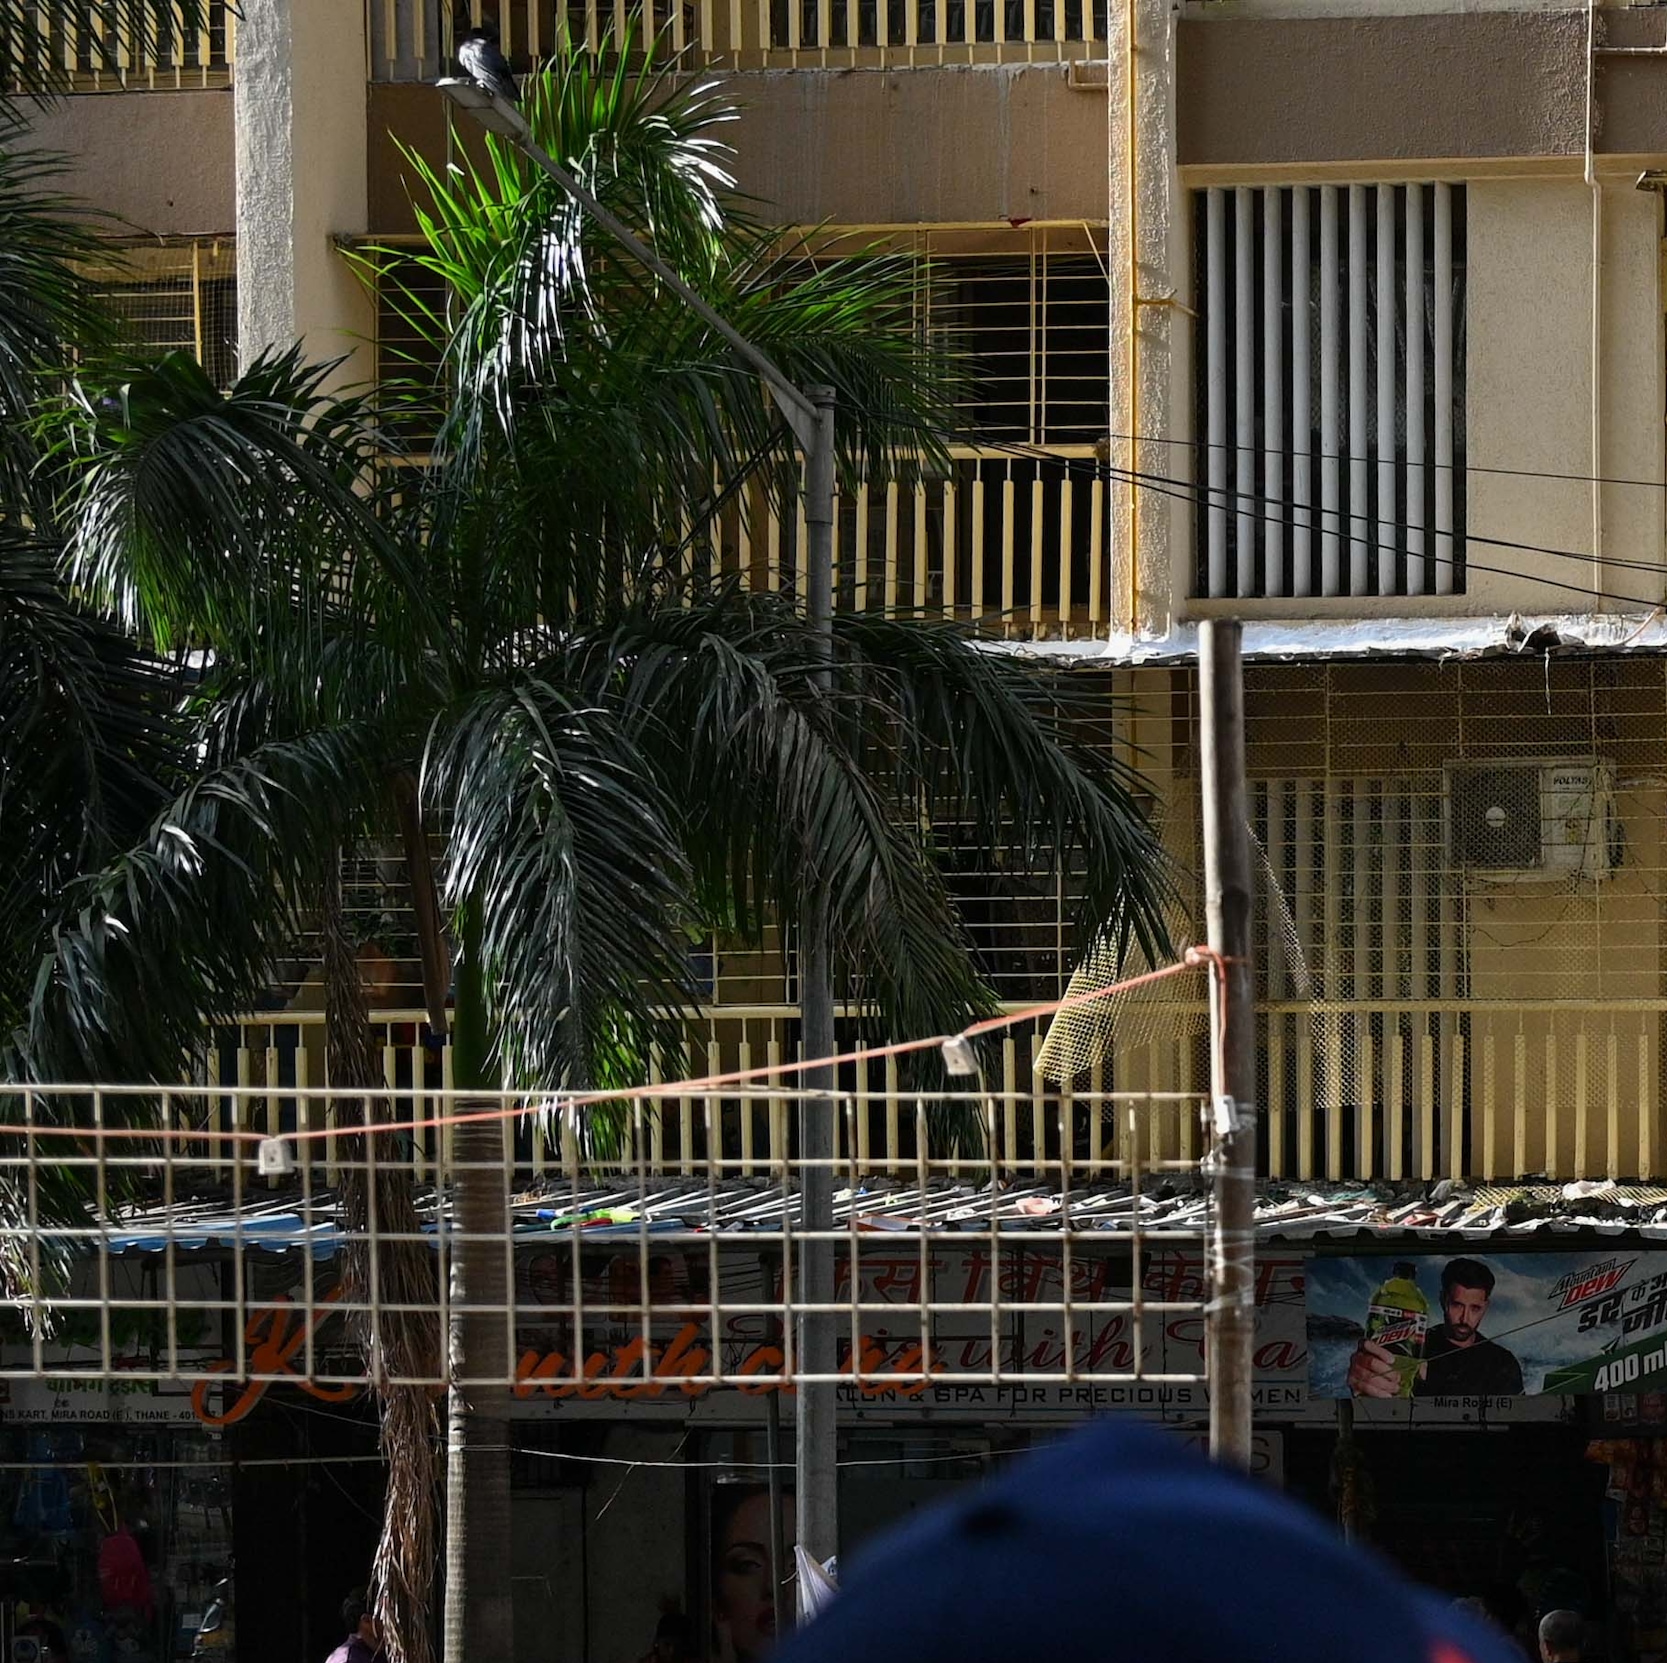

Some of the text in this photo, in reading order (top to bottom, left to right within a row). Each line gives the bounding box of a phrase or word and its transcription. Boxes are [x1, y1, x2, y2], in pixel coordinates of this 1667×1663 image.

[1593, 1353, 1640, 1393] 400
[934, 1386, 983, 1403] SPA
[1011, 1386, 1051, 1403] FOR
[1058, 1386, 1192, 1403] PRECIOUS
[1433, 1397, 1460, 1409] Mira
[51, 1409, 77, 1421] MIRA
[80, 1409, 110, 1421] ROAD
[135, 1409, 170, 1421] THANE
